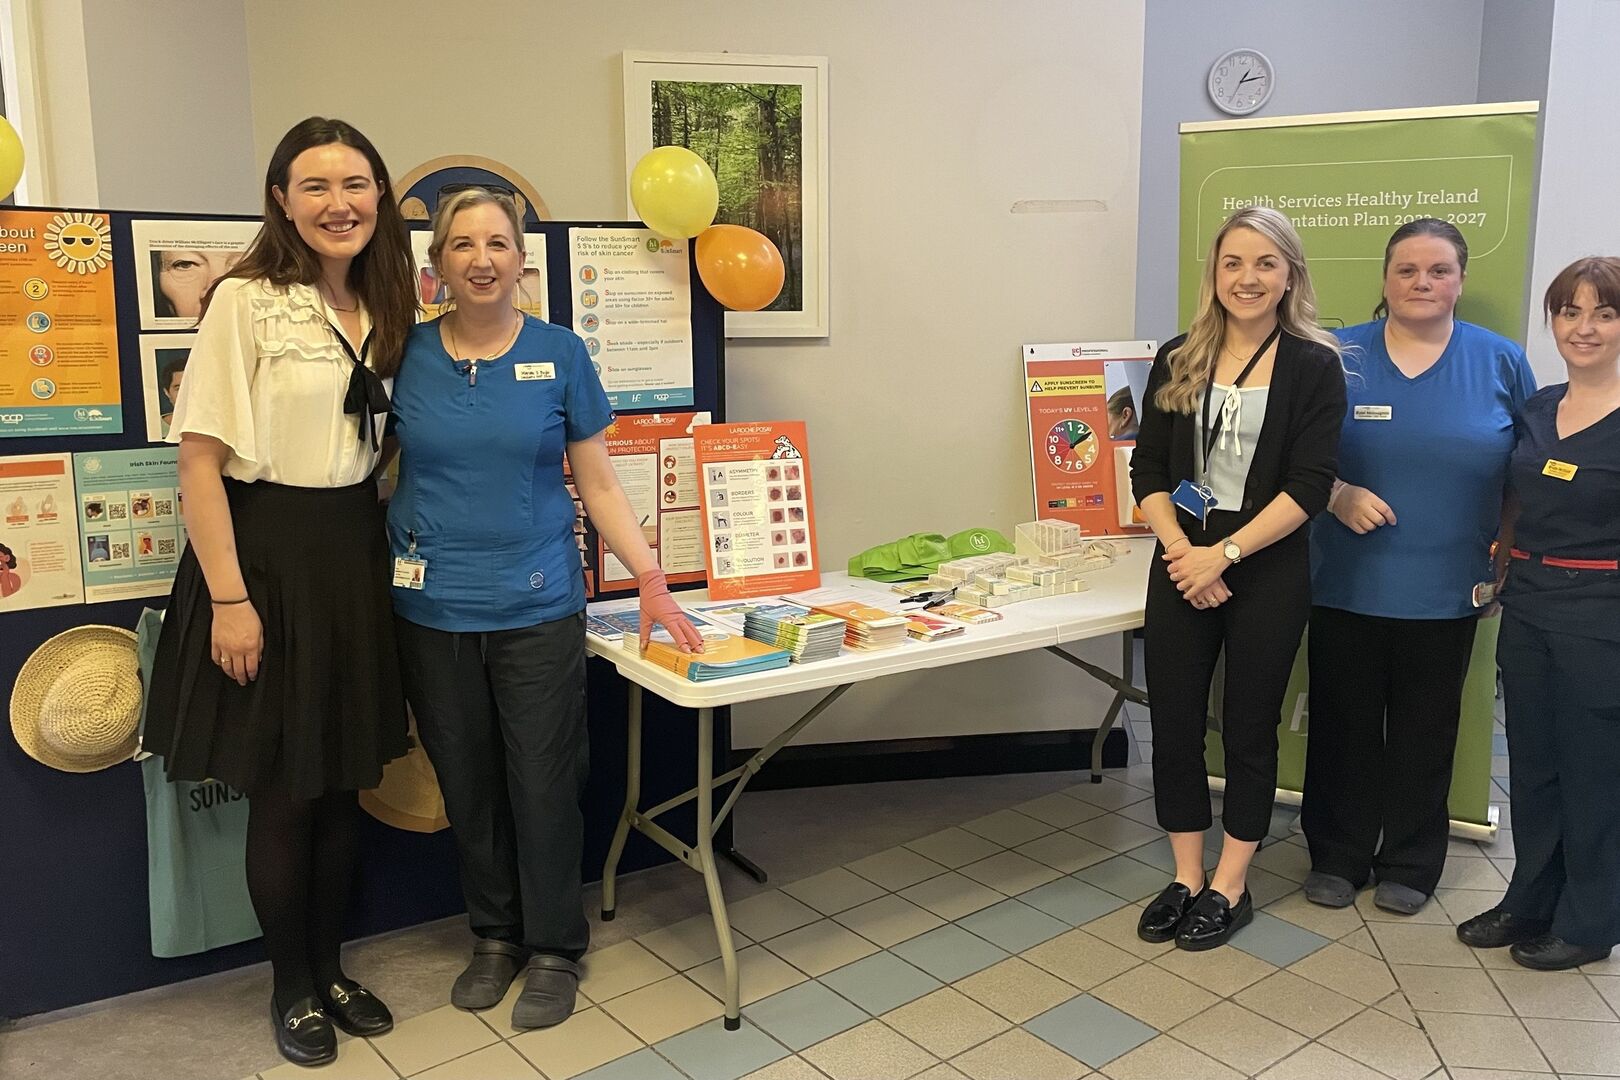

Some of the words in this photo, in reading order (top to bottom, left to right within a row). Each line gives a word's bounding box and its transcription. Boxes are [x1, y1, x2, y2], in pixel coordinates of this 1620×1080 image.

[1222, 195, 1275, 210] Health
[1278, 194, 1342, 209] Services
[1346, 190, 1414, 209] Healthy
[1416, 188, 1480, 205] Ireland
[1353, 211, 1390, 226] Plan
[1447, 212, 1487, 228] 2027
[1067, 421, 1073, 431] 1
[1077, 424, 1085, 434] 2
[721, 437, 739, 445] YOUR
[1049, 435, 1059, 443] 10
[617, 445, 657, 453] PROTECTION
[1049, 445, 1057, 454] 9
[1088, 444, 1096, 454] 4
[1055, 455, 1062, 465] 8
[1085, 454, 1092, 464] 5
[1065, 460, 1073, 470] 7
[1075, 460, 1083, 470] 6
[190, 783, 249, 812] SUN
